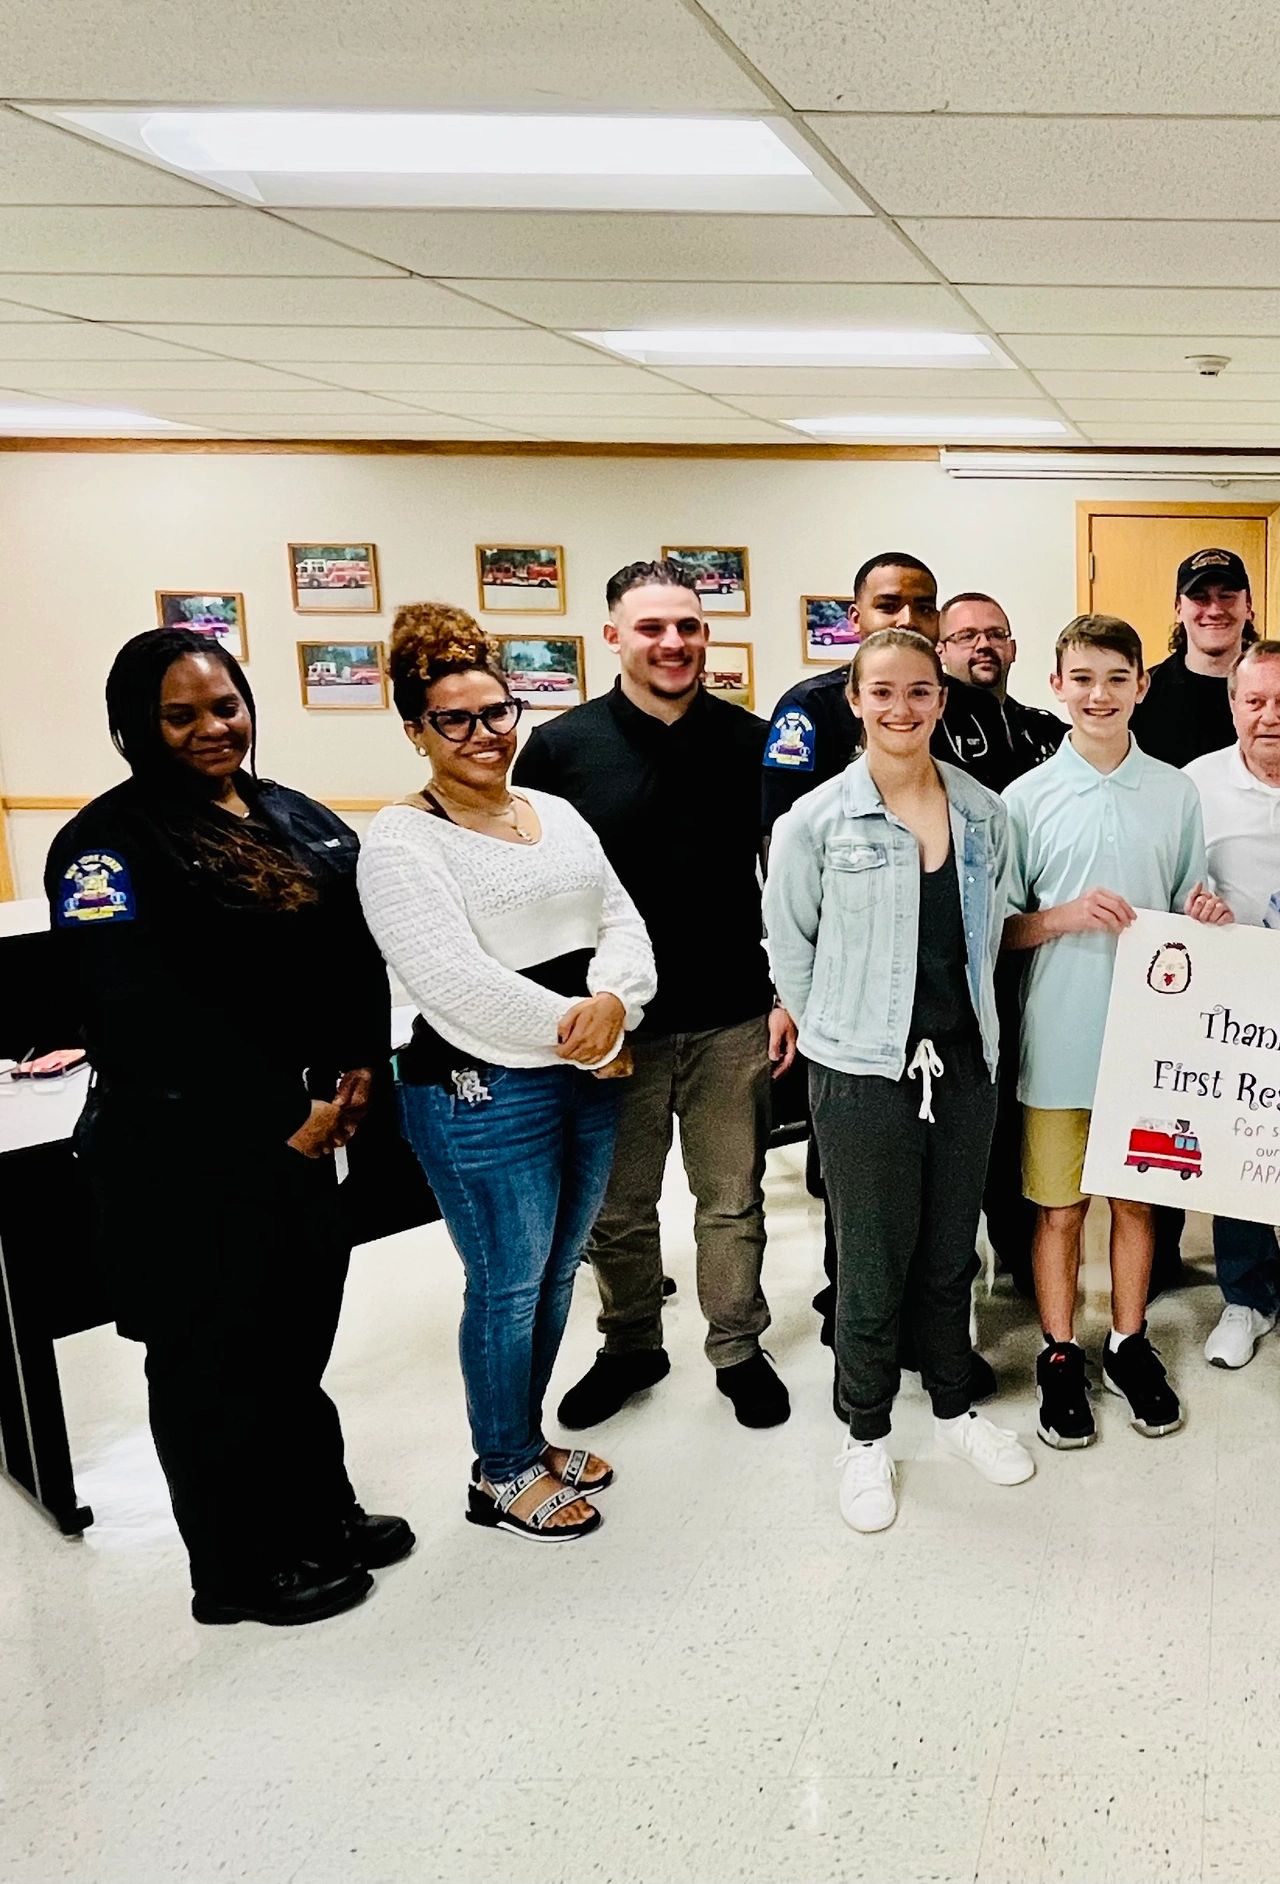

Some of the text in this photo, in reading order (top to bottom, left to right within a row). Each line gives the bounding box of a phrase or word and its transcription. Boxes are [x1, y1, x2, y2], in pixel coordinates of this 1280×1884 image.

[1152, 1059, 1224, 1099] First
[1232, 1116, 1265, 1137] for
[1255, 1147, 1280, 1158] our
